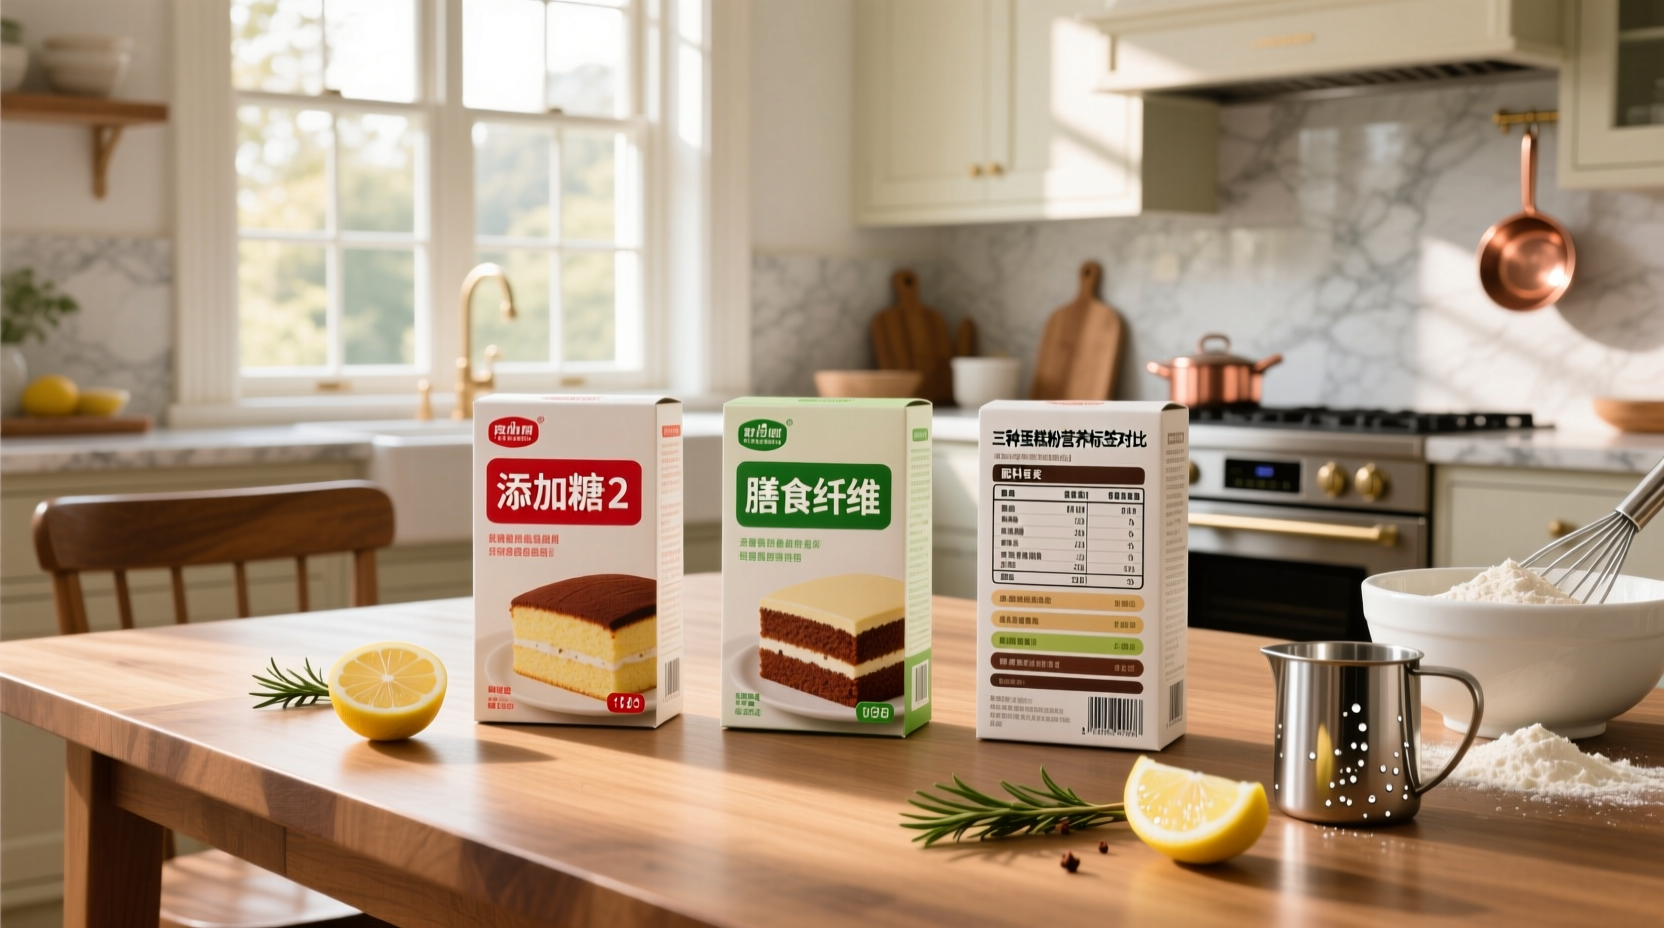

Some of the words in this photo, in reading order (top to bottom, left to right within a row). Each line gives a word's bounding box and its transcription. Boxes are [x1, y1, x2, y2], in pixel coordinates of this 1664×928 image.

[497, 472, 629, 512] 添加糖2
[745, 476, 881, 516] 膳食纤维
